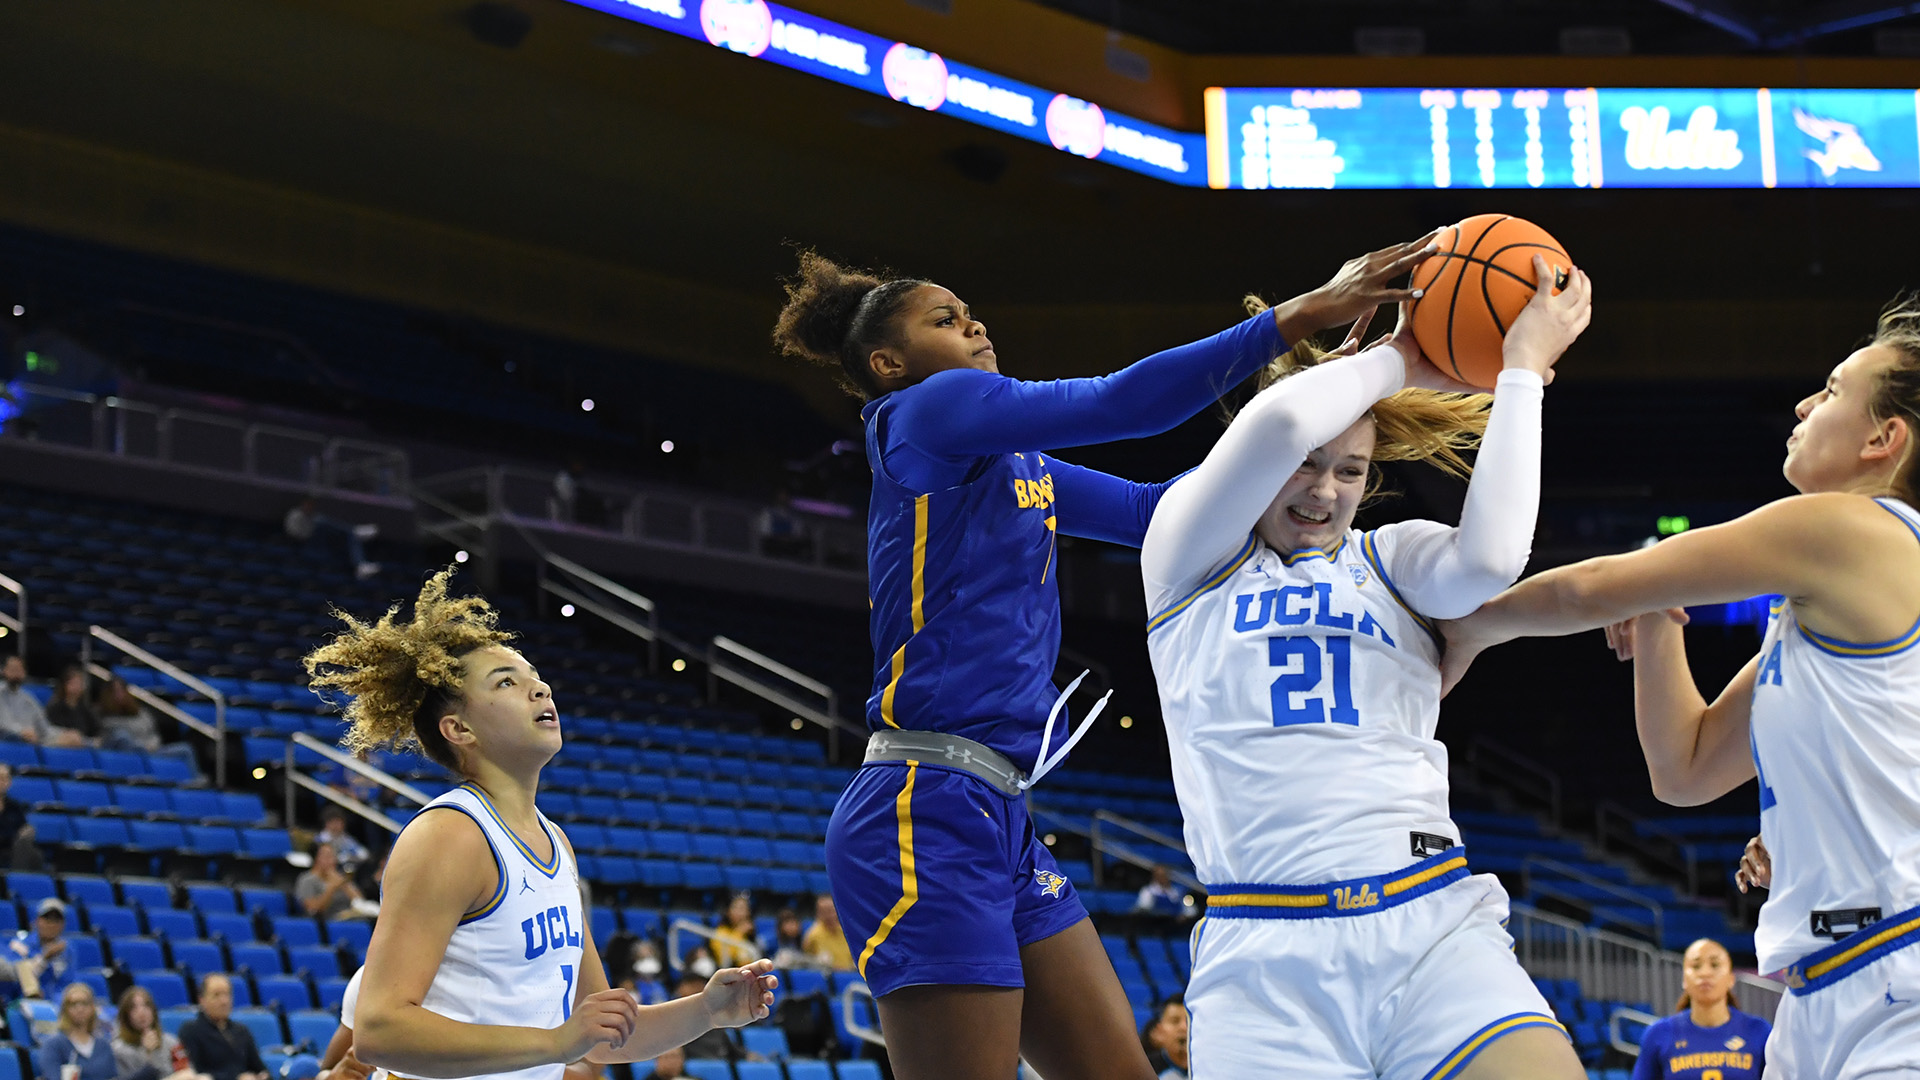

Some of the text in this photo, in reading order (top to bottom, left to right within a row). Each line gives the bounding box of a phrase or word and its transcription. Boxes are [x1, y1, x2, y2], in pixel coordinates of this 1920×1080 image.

[1619, 105, 1743, 170] Ucla
[1233, 582, 1396, 648] UCLA
[1268, 635, 1359, 727] 21
[1333, 883, 1380, 910] Ucla
[521, 905, 585, 961] UCL
